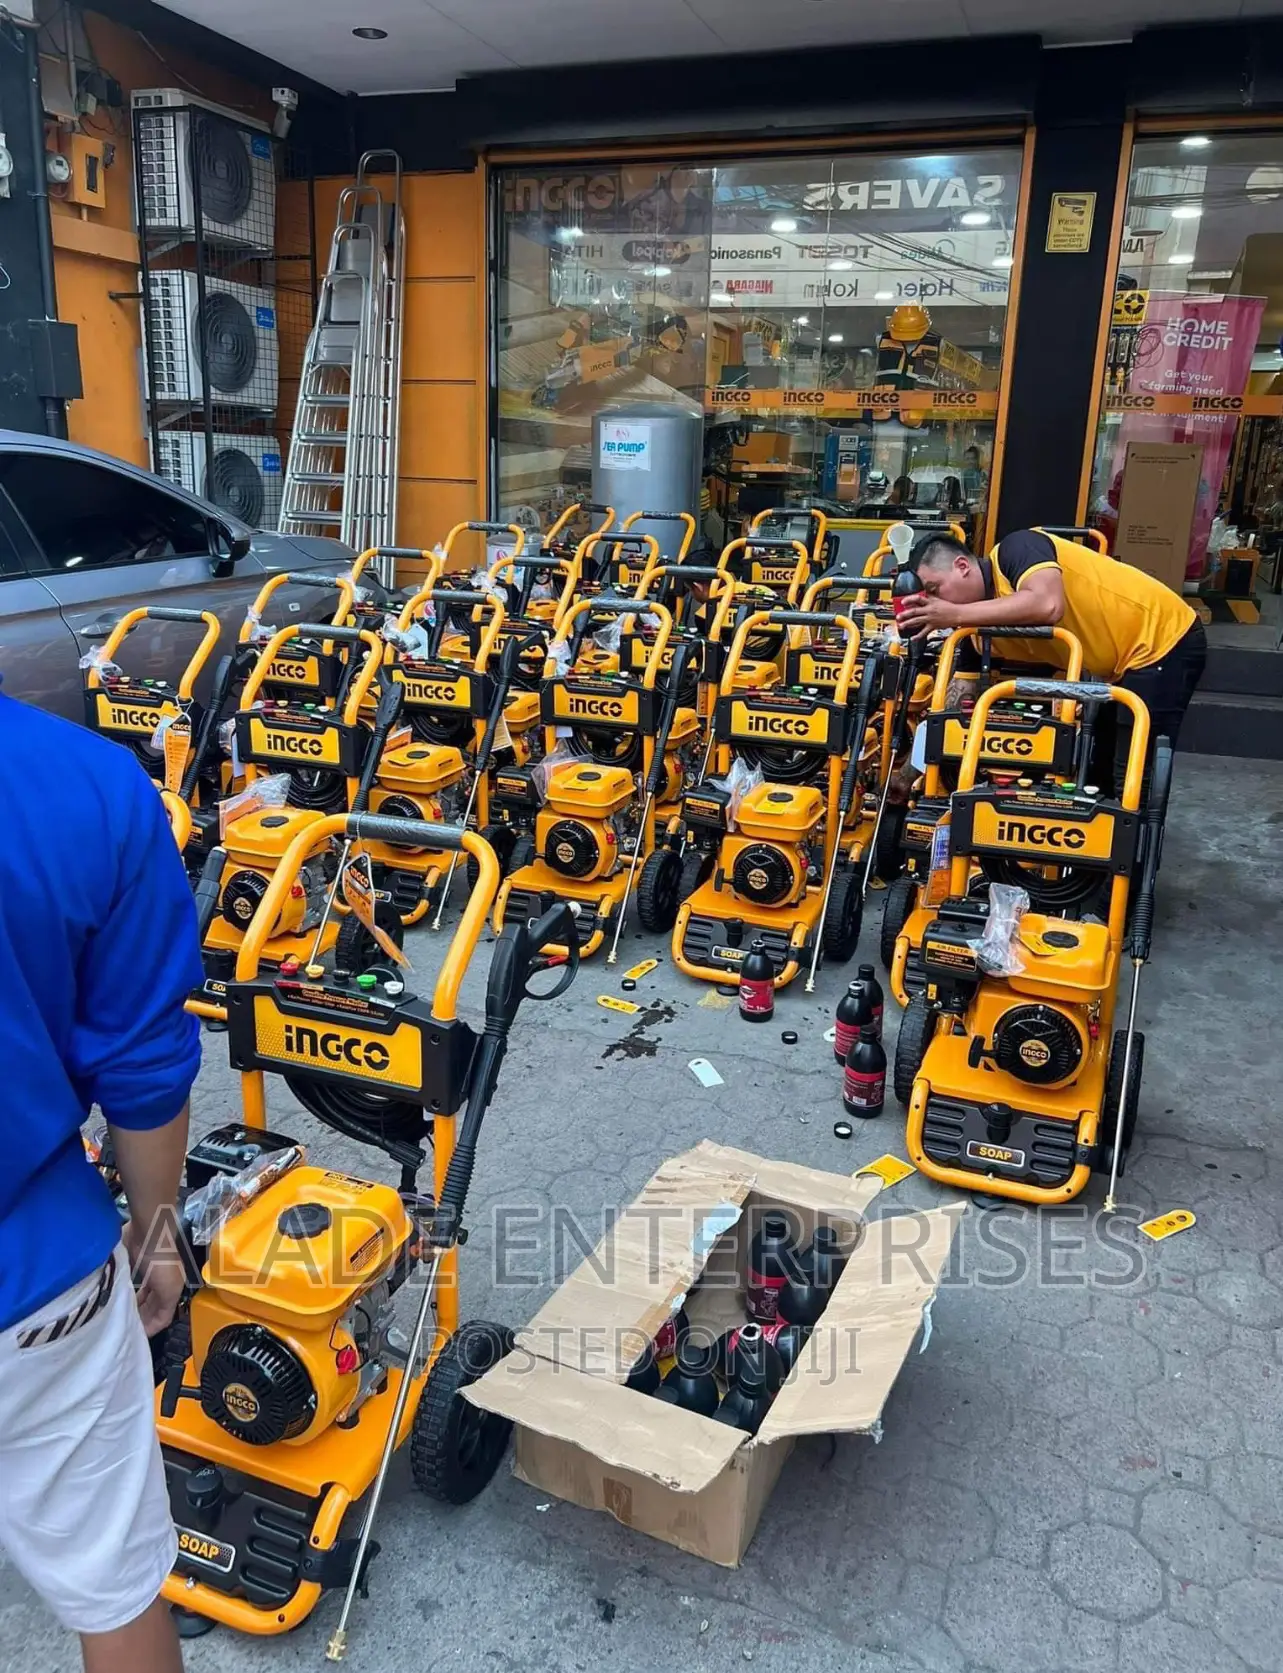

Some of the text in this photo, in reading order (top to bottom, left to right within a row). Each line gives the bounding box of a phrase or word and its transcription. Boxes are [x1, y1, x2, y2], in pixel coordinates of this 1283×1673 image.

[1167, 317, 1229, 335] HOME
[1163, 332, 1233, 351] CREDIT
[1164, 369, 1214, 383] Get your
[978, 1145, 1013, 1161] SOAP
[179, 1532, 220, 1559] SOAP
